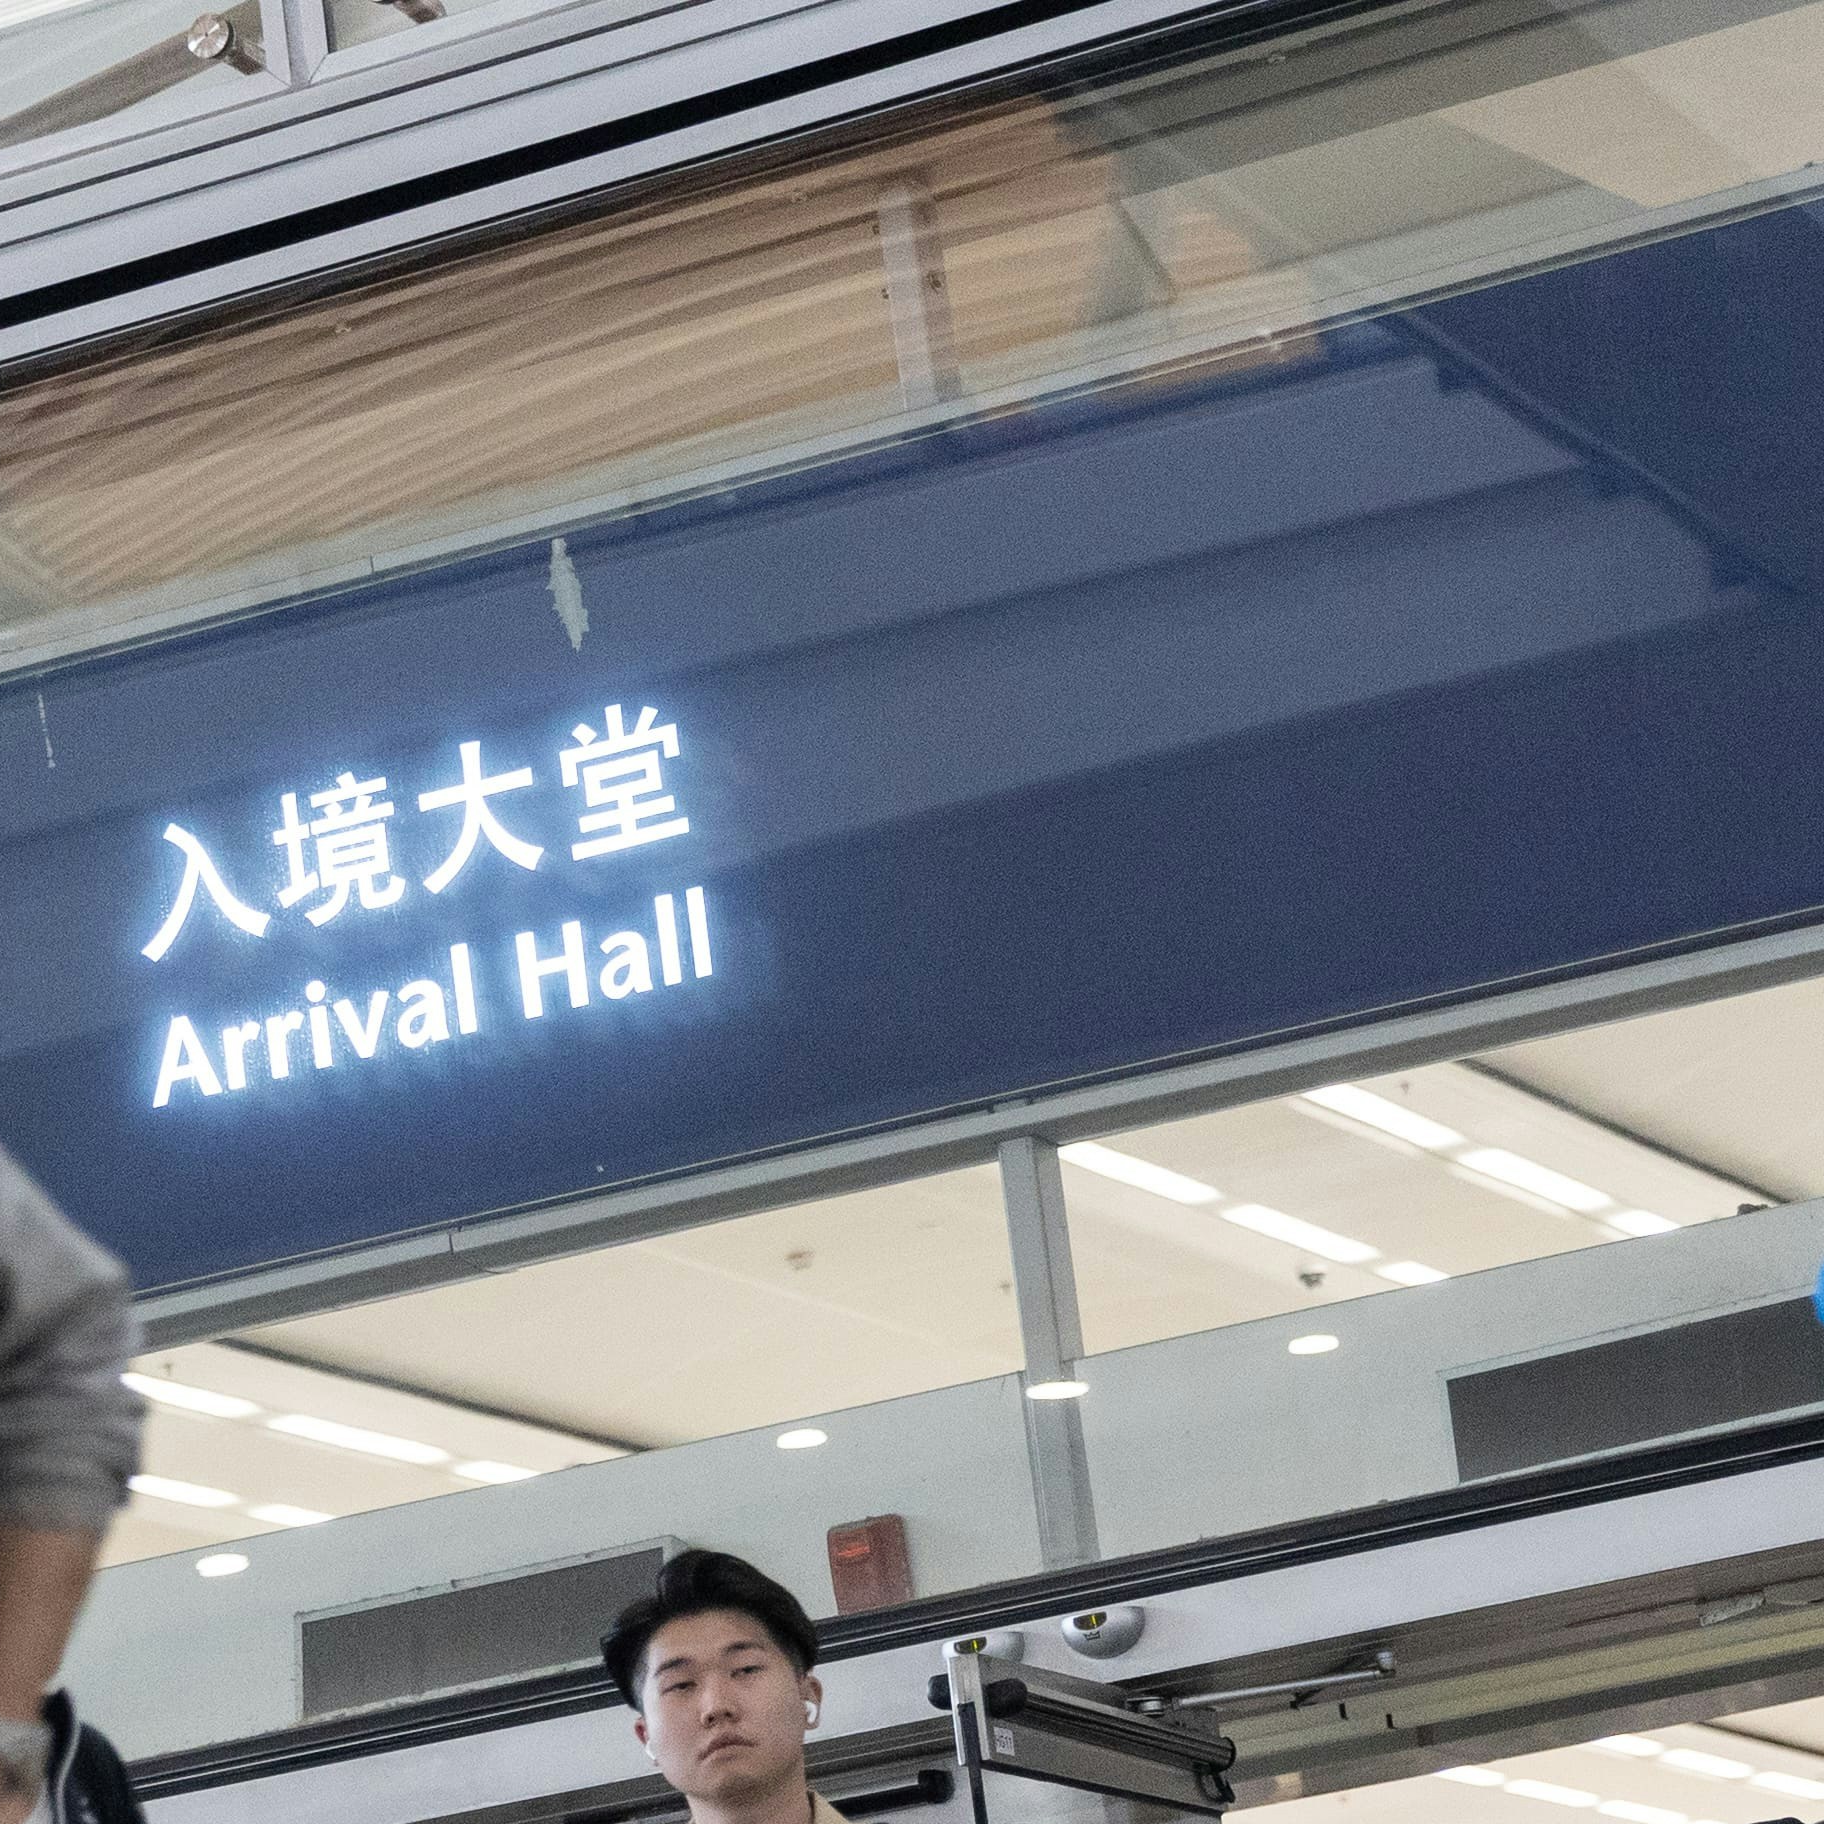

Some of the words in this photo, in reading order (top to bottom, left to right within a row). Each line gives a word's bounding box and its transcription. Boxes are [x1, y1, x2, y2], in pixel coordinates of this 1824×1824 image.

[141, 703, 690, 963] 入境大堂
[152, 942, 478, 1109] Arrival
[515, 886, 714, 1019] Hall
